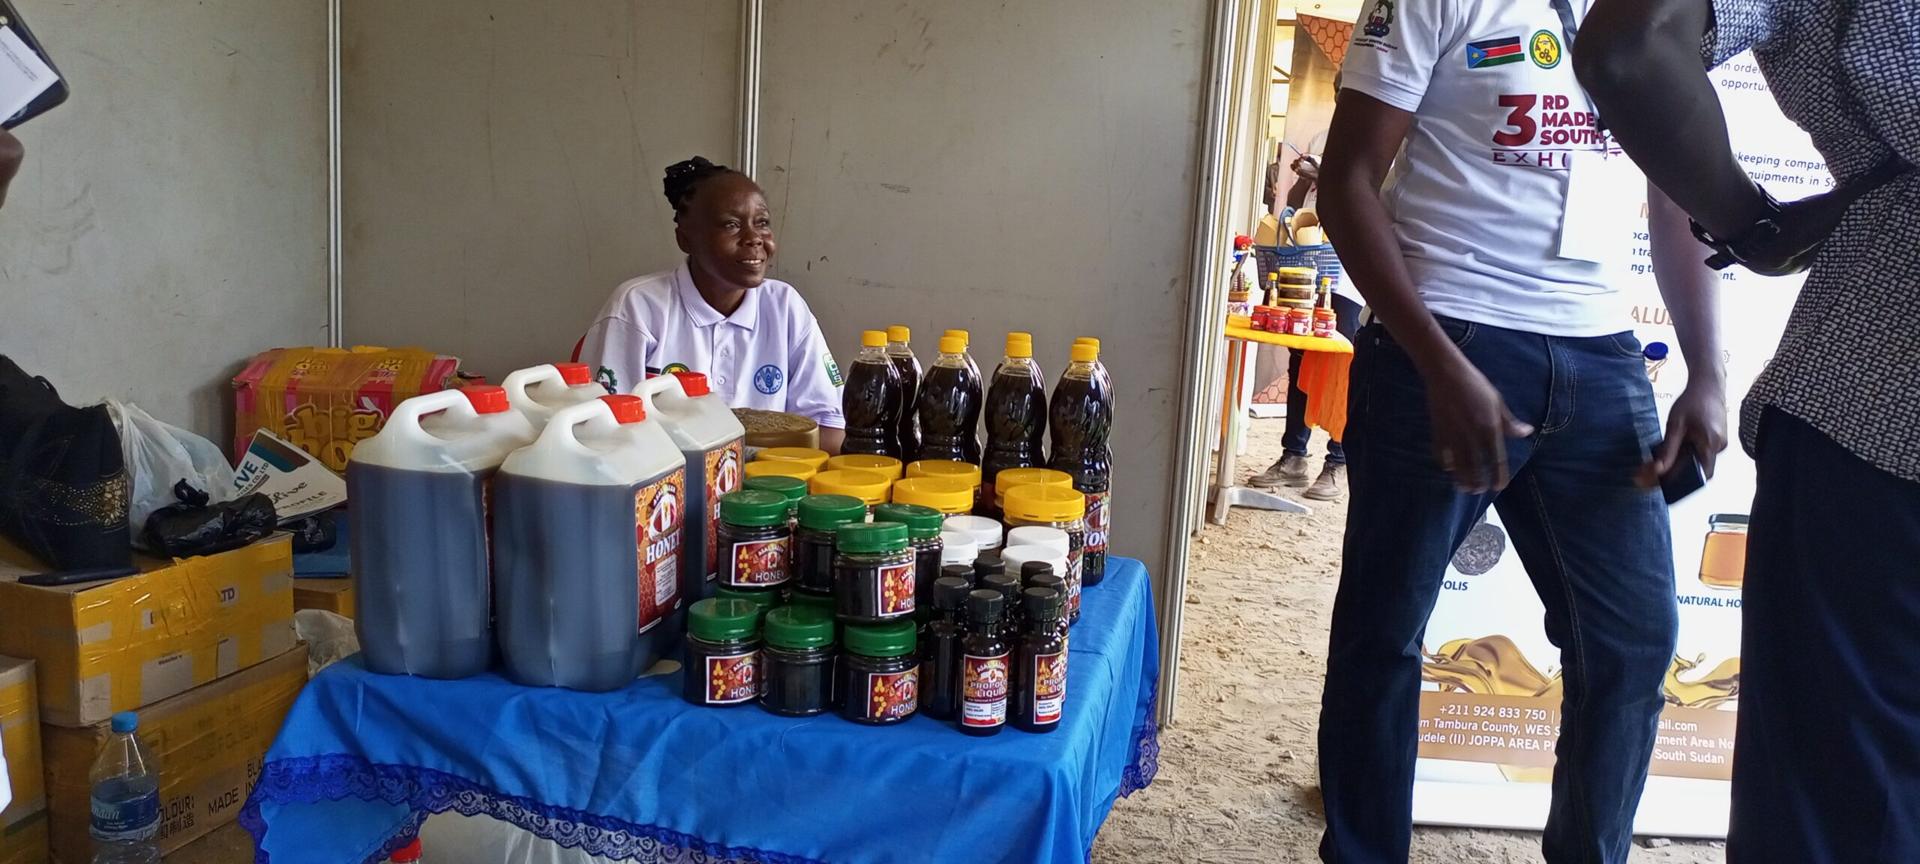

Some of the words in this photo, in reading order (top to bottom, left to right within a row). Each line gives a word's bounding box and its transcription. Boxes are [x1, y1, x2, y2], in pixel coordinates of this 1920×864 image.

[1542, 94, 1570, 110] RD
[1492, 94, 1537, 147] 3
[1541, 112, 1595, 128] MADE
[1539, 129, 1604, 146] SOUTH
[1735, 151, 1781, 169] keeping
[1809, 174, 1820, 186] in
[1677, 595, 1724, 608] NATURAL
[1439, 704, 1469, 716] +211
[1473, 705, 1495, 717] 924
[1498, 707, 1521, 719] 833
[1525, 709, 1547, 720] 750
[1433, 718, 1478, 731] Tambura
[1481, 721, 1521, 735] County,
[1525, 724, 1551, 736] WES
[1468, 735, 1506, 748] JOPPA
[1508, 738, 1541, 750] AREA
[1690, 736, 1715, 748] Area
[1654, 748, 1687, 762] South
[1689, 750, 1726, 764] Sudan
[208, 787, 240, 816] MADE
